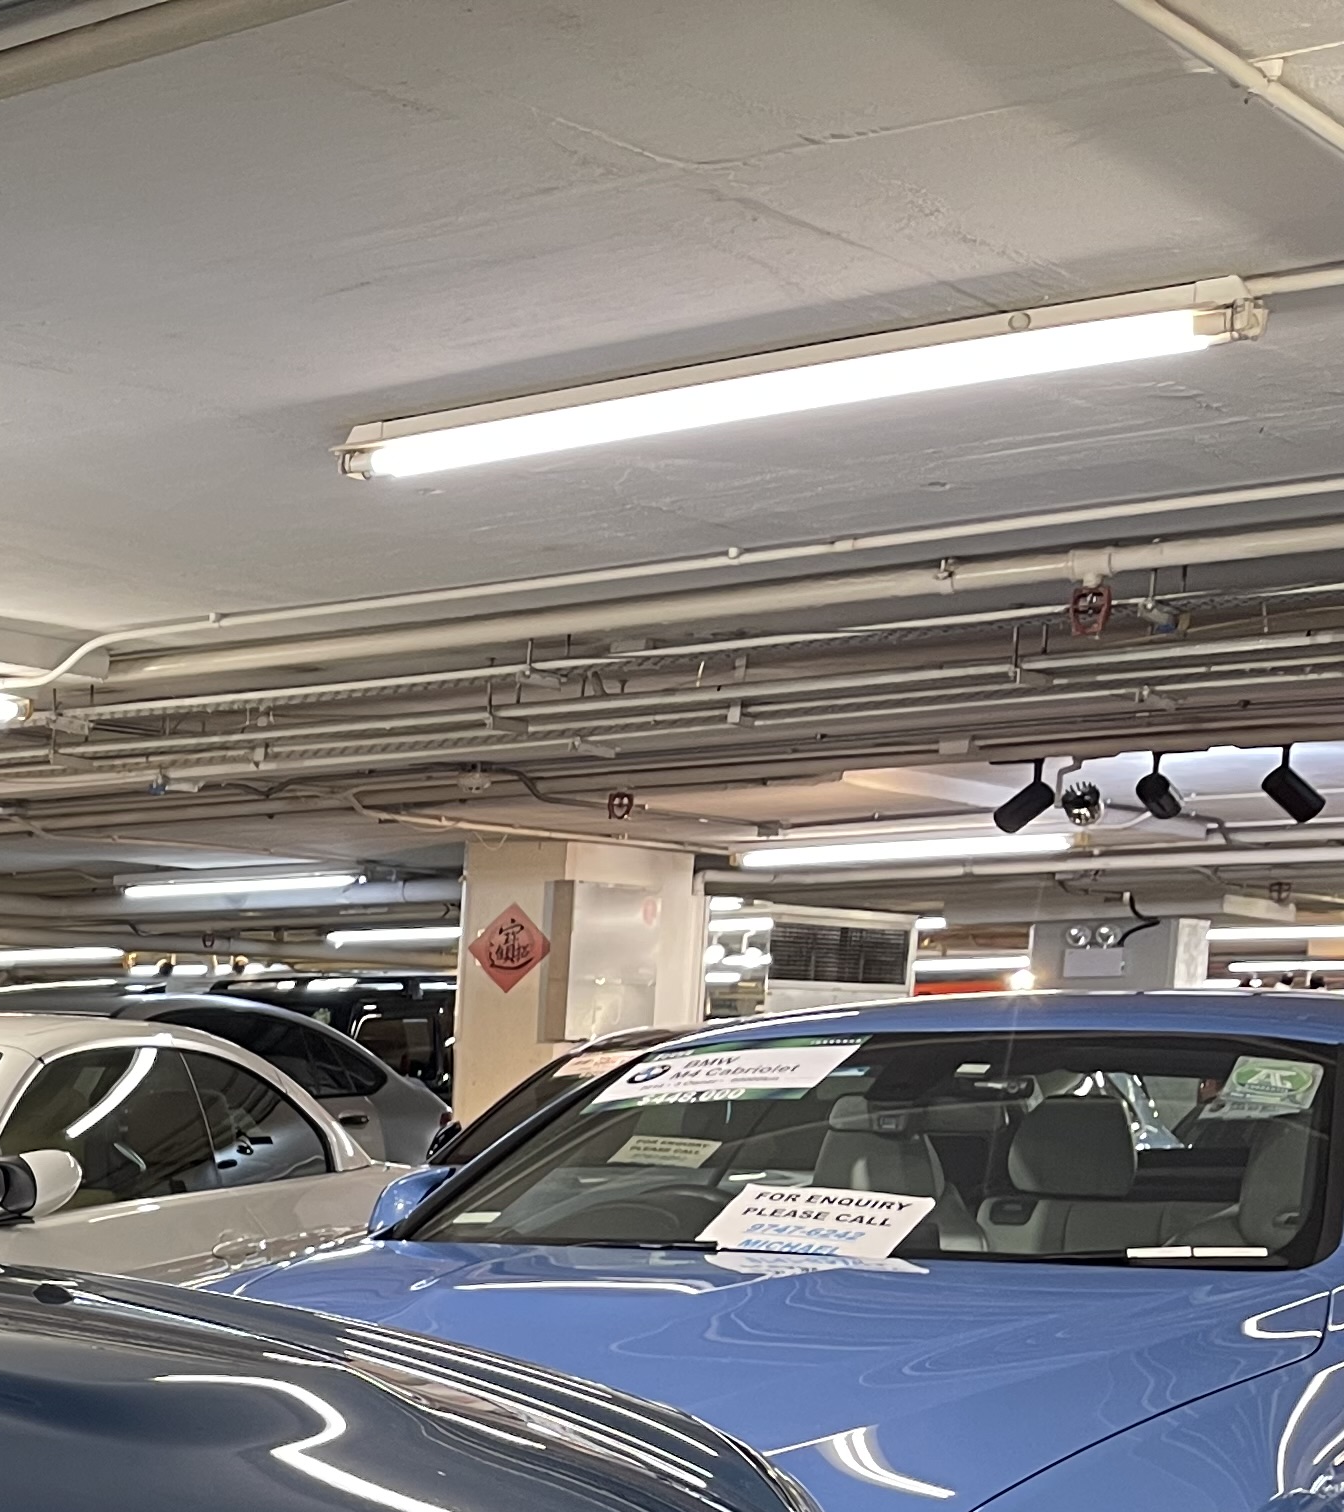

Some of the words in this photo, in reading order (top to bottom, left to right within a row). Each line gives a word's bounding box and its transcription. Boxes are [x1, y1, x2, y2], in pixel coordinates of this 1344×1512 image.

[669, 1069, 701, 1079] M4
[706, 1064, 800, 1076] Cabriolet
[683, 1056, 741, 1069] BMW
[637, 1088, 746, 1106] $448,000
[755, 1191, 801, 1201] FOR
[805, 1194, 913, 1211] ENQUIRY
[742, 1207, 830, 1221] PLEASE
[835, 1213, 892, 1227] CALL
[744, 1223, 866, 1241] 9747-6242
[737, 1238, 841, 1255] MICHAEL
